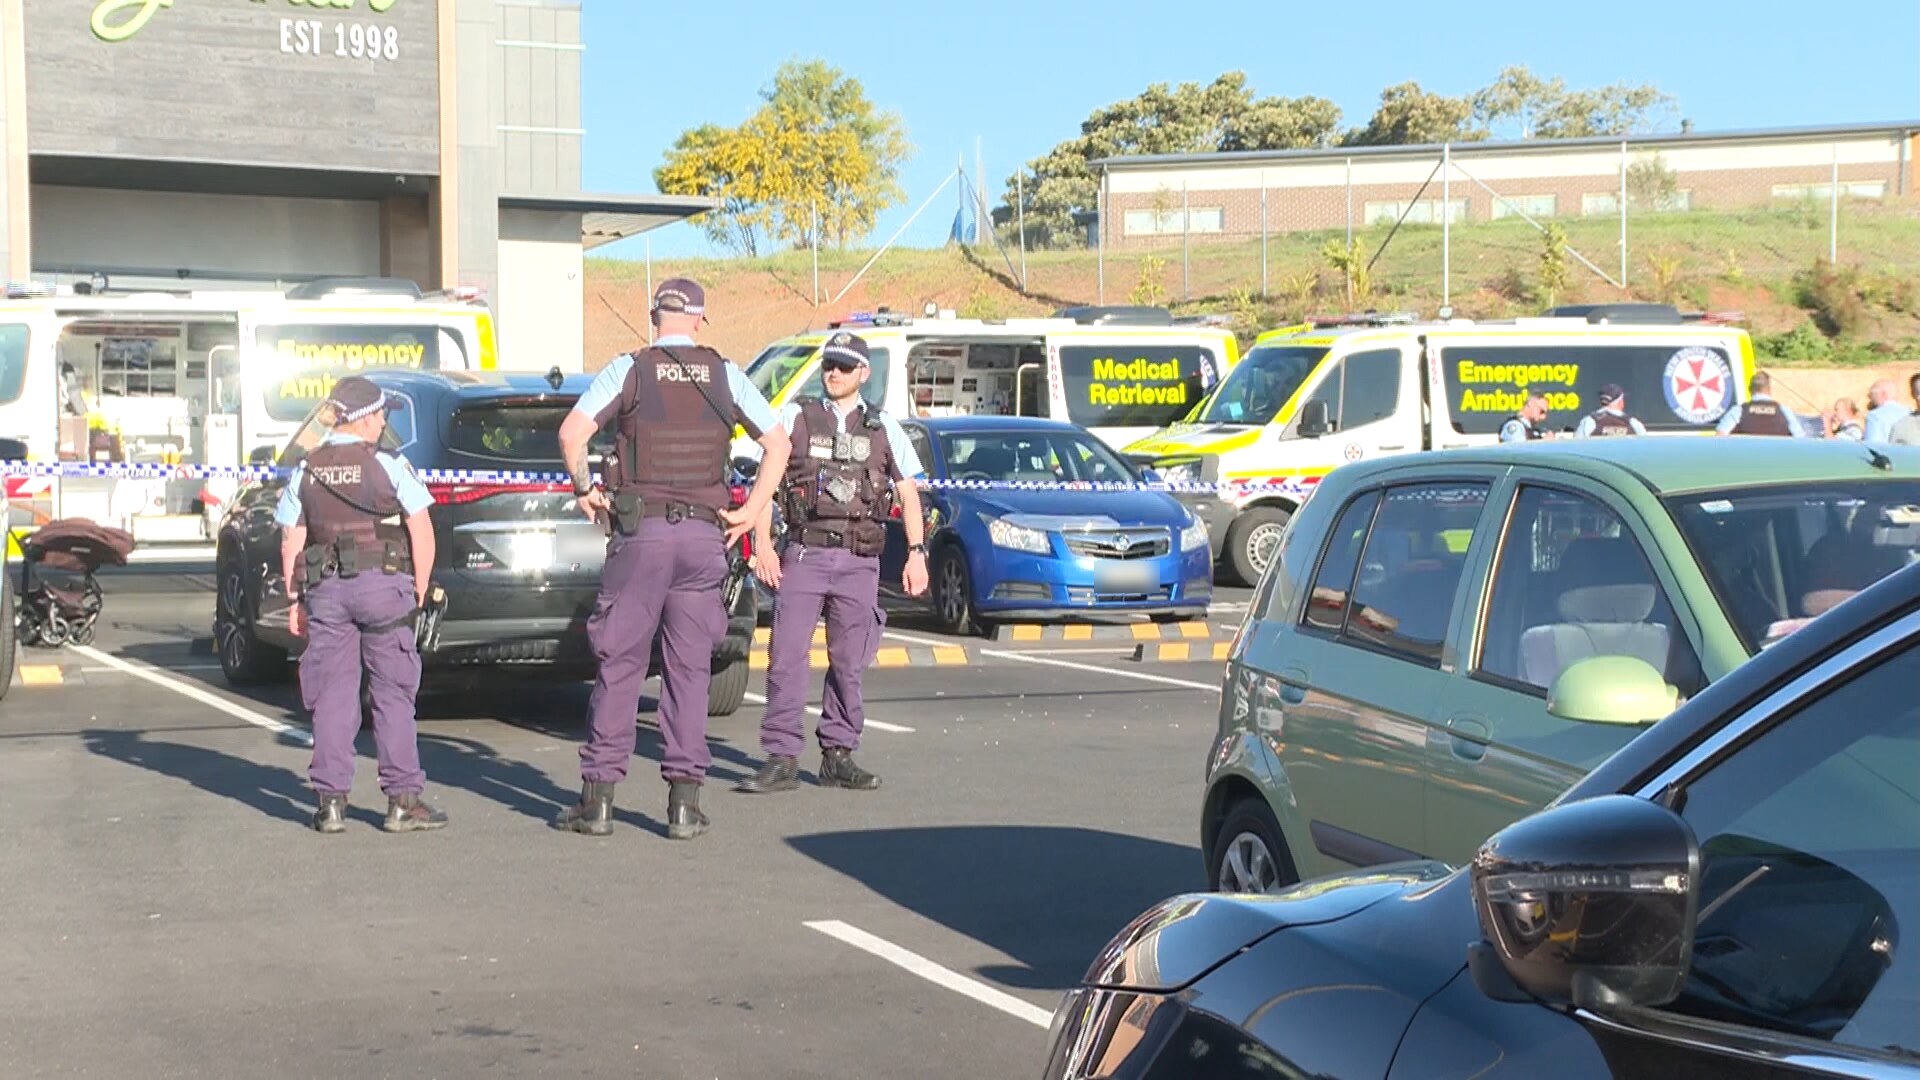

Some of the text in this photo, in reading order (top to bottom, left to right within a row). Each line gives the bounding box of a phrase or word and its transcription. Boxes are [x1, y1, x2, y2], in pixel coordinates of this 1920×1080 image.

[280, 19, 399, 60] EST 1998
[277, 338, 423, 369] Emergency
[656, 368, 710, 382] POLICE
[1092, 358, 1180, 381] Medical
[1459, 360, 1578, 386] Emergency
[1089, 382, 1187, 406] Retrieval
[1460, 388, 1580, 412] Ambulnce
[1749, 404, 1777, 415] POLICE
[310, 471, 361, 485] POLICE
